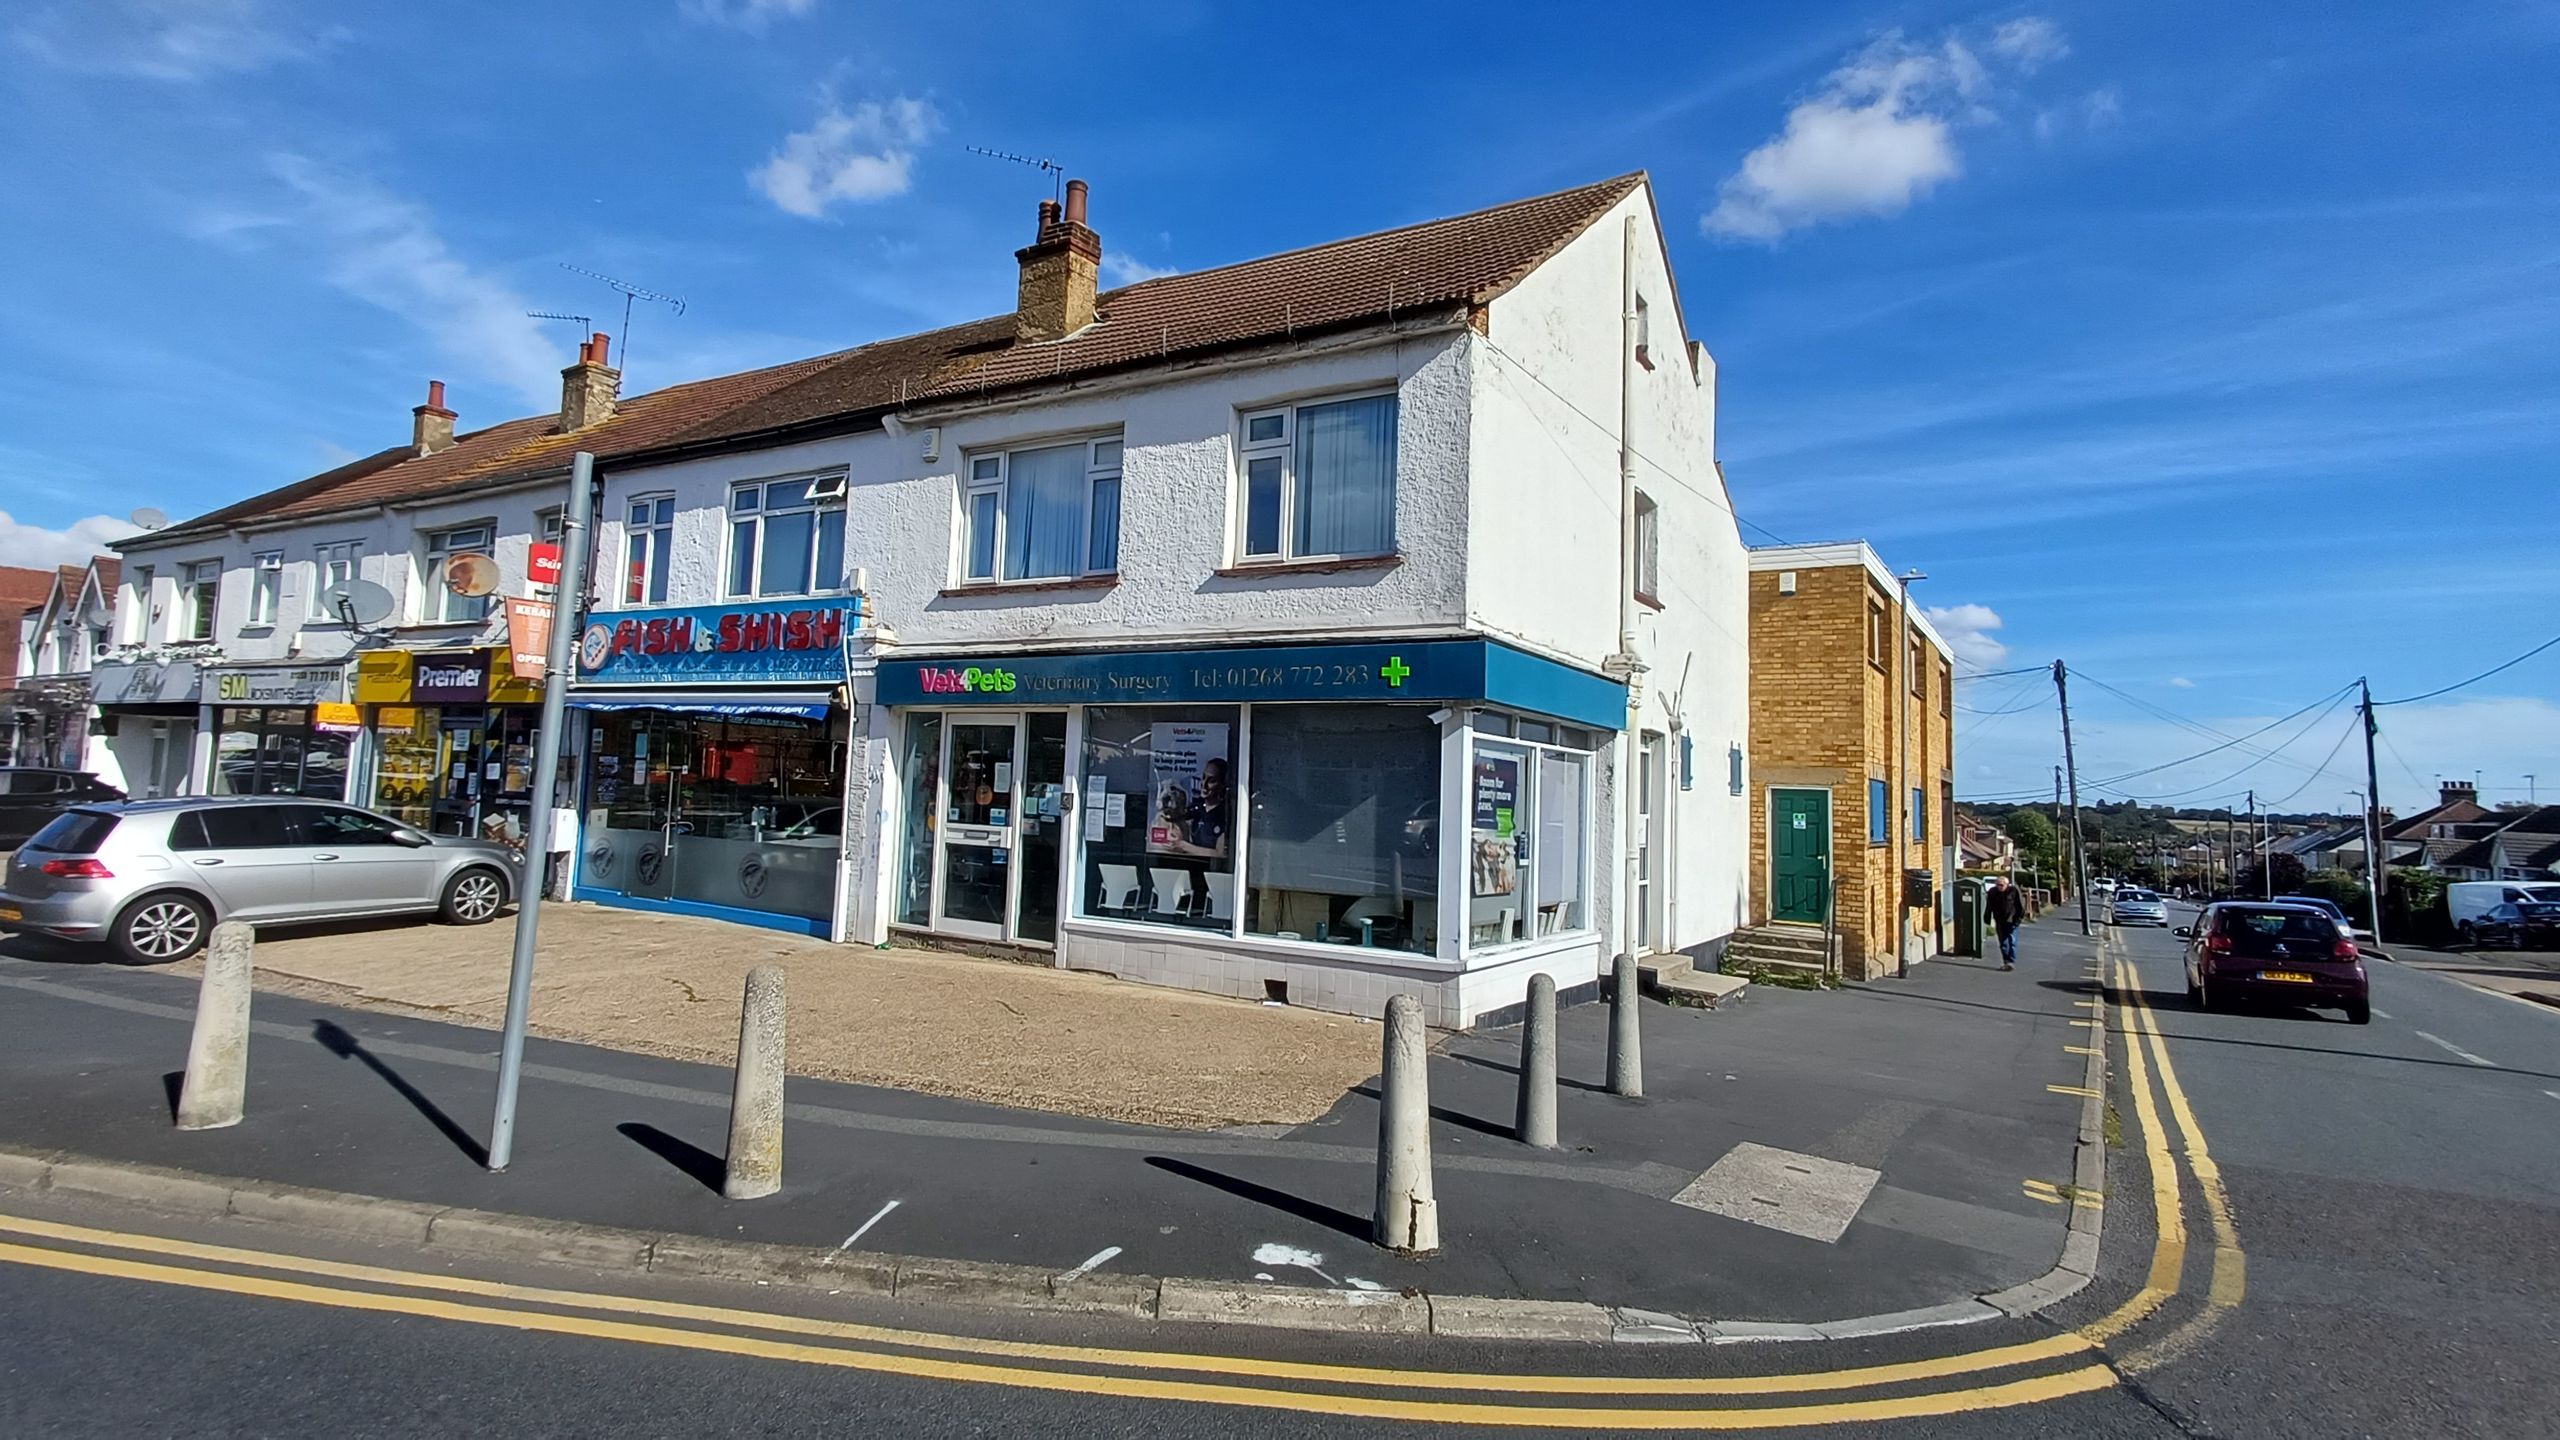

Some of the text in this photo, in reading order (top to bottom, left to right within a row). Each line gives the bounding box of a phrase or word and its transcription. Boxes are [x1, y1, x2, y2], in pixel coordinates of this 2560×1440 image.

[612, 608, 847, 656] FISH & SHISH
[516, 653, 546, 665] OPEN
[220, 674, 247, 700] SM
[418, 665, 483, 688] Premier
[919, 667, 1017, 693] Vets4Pets
[1024, 664, 1369, 695] Veterinary Surgery Tel: 01268 772 283
[1479, 775, 1504, 788] Room for
[1479, 787, 1512, 802] plenty more
